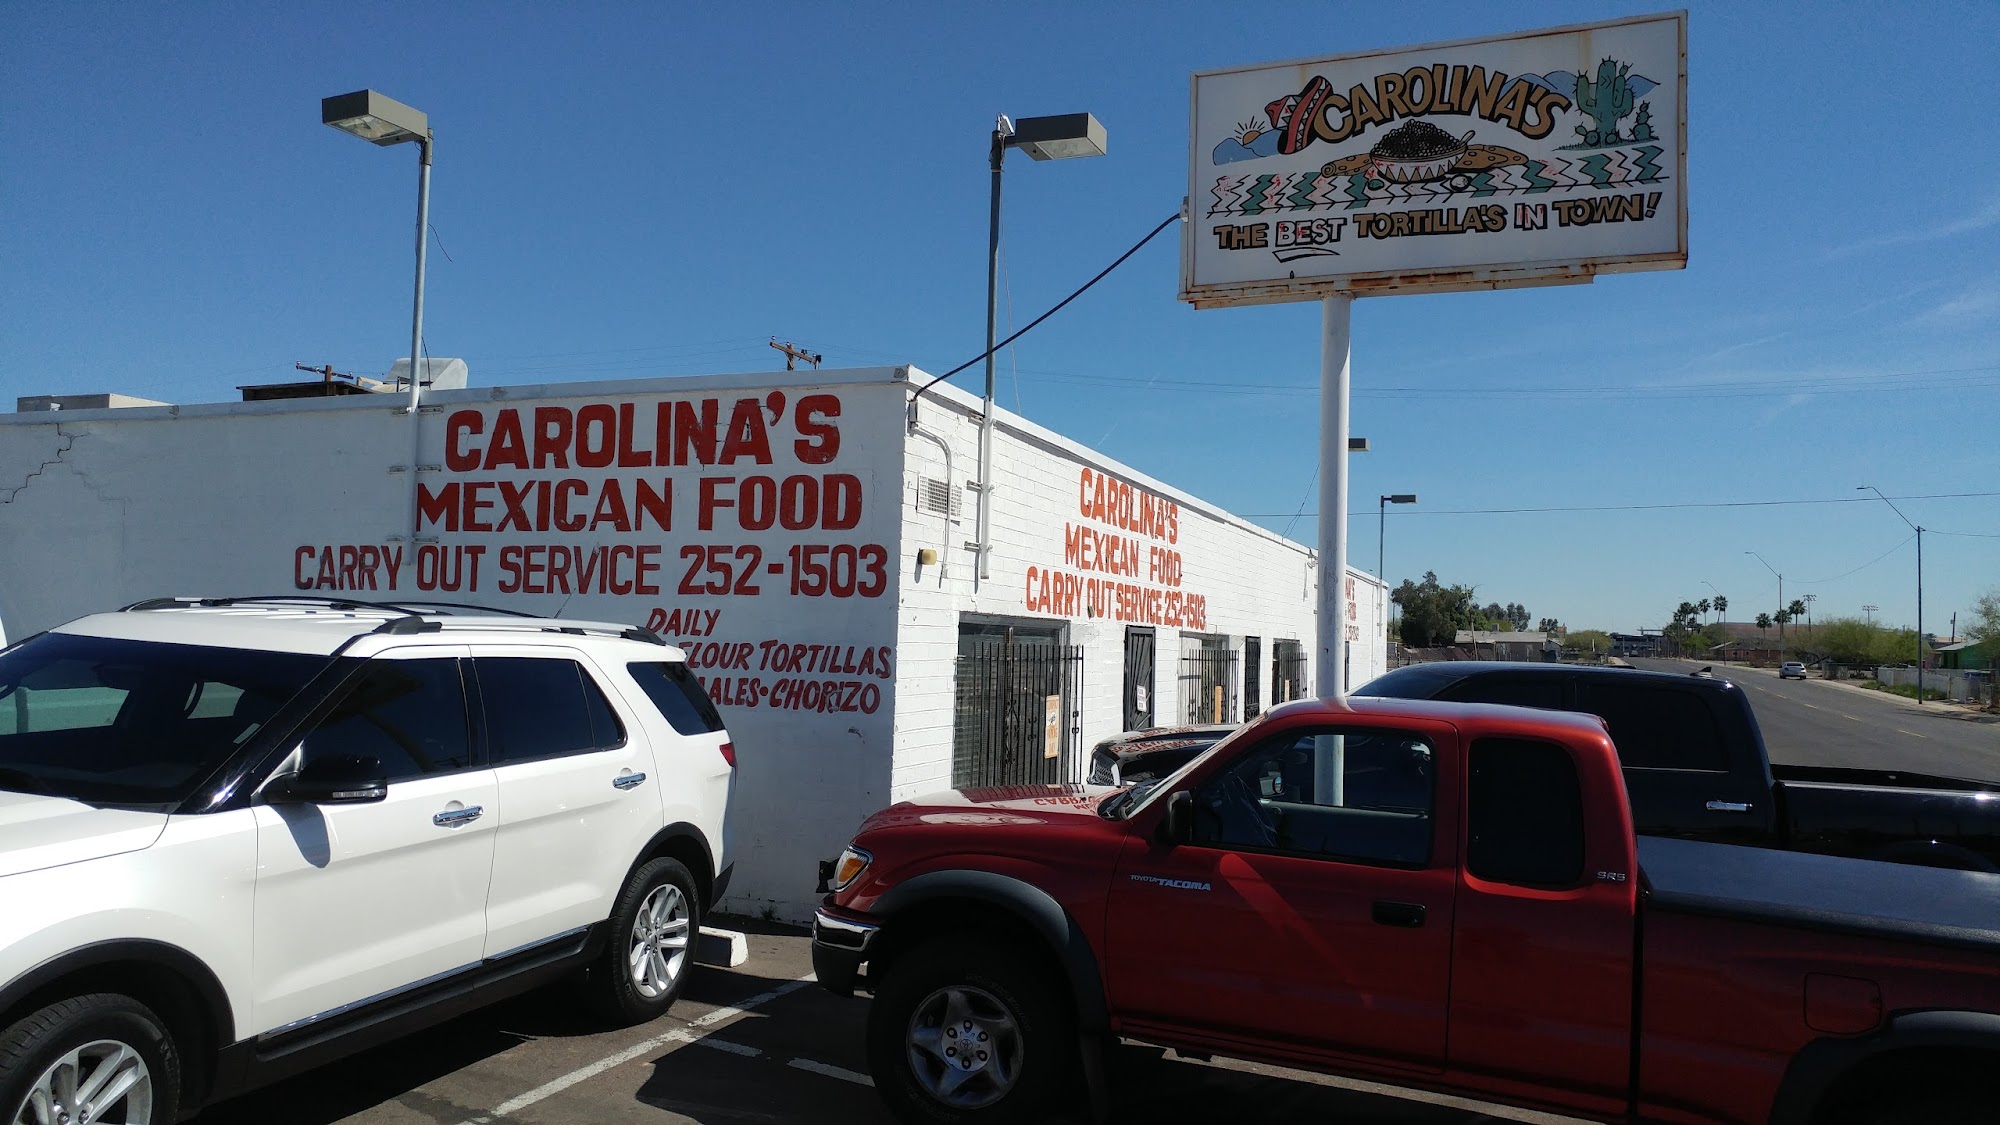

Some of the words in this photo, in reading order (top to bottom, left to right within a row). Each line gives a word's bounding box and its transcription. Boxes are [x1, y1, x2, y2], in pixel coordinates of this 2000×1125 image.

[1313, 63, 1572, 143] CAROLINA'S
[1213, 222, 1269, 250] THE
[1275, 217, 1347, 248] BEST
[1353, 204, 1508, 239] TORTILLA'S
[1514, 203, 1547, 230] IN
[1552, 192, 1662, 227] TOWN!
[445, 391, 842, 472] CAROLINA'S
[415, 477, 673, 532] MEXICAN
[700, 473, 863, 531] FOOD
[1080, 467, 1178, 544] CAROLINA'S
[294, 545, 402, 591] CARRY
[416, 545, 486, 592] OUT
[498, 544, 661, 595] SERVICE
[678, 543, 888, 597] 252-1503
[1065, 522, 1139, 577] MEXICAN
[1150, 545, 1182, 587] FOOD
[645, 607, 721, 637] DAILY
[1026, 566, 1084, 617] CARRY
[1087, 578, 1115, 619] OUT
[1115, 582, 1162, 625] SERVICE
[1164, 590, 1207, 630] 252-1503
[759, 640, 892, 679] TORTILLAS
[1129, 874, 1158, 883] TOYOTA
[1157, 878, 1211, 891] TACOMA
